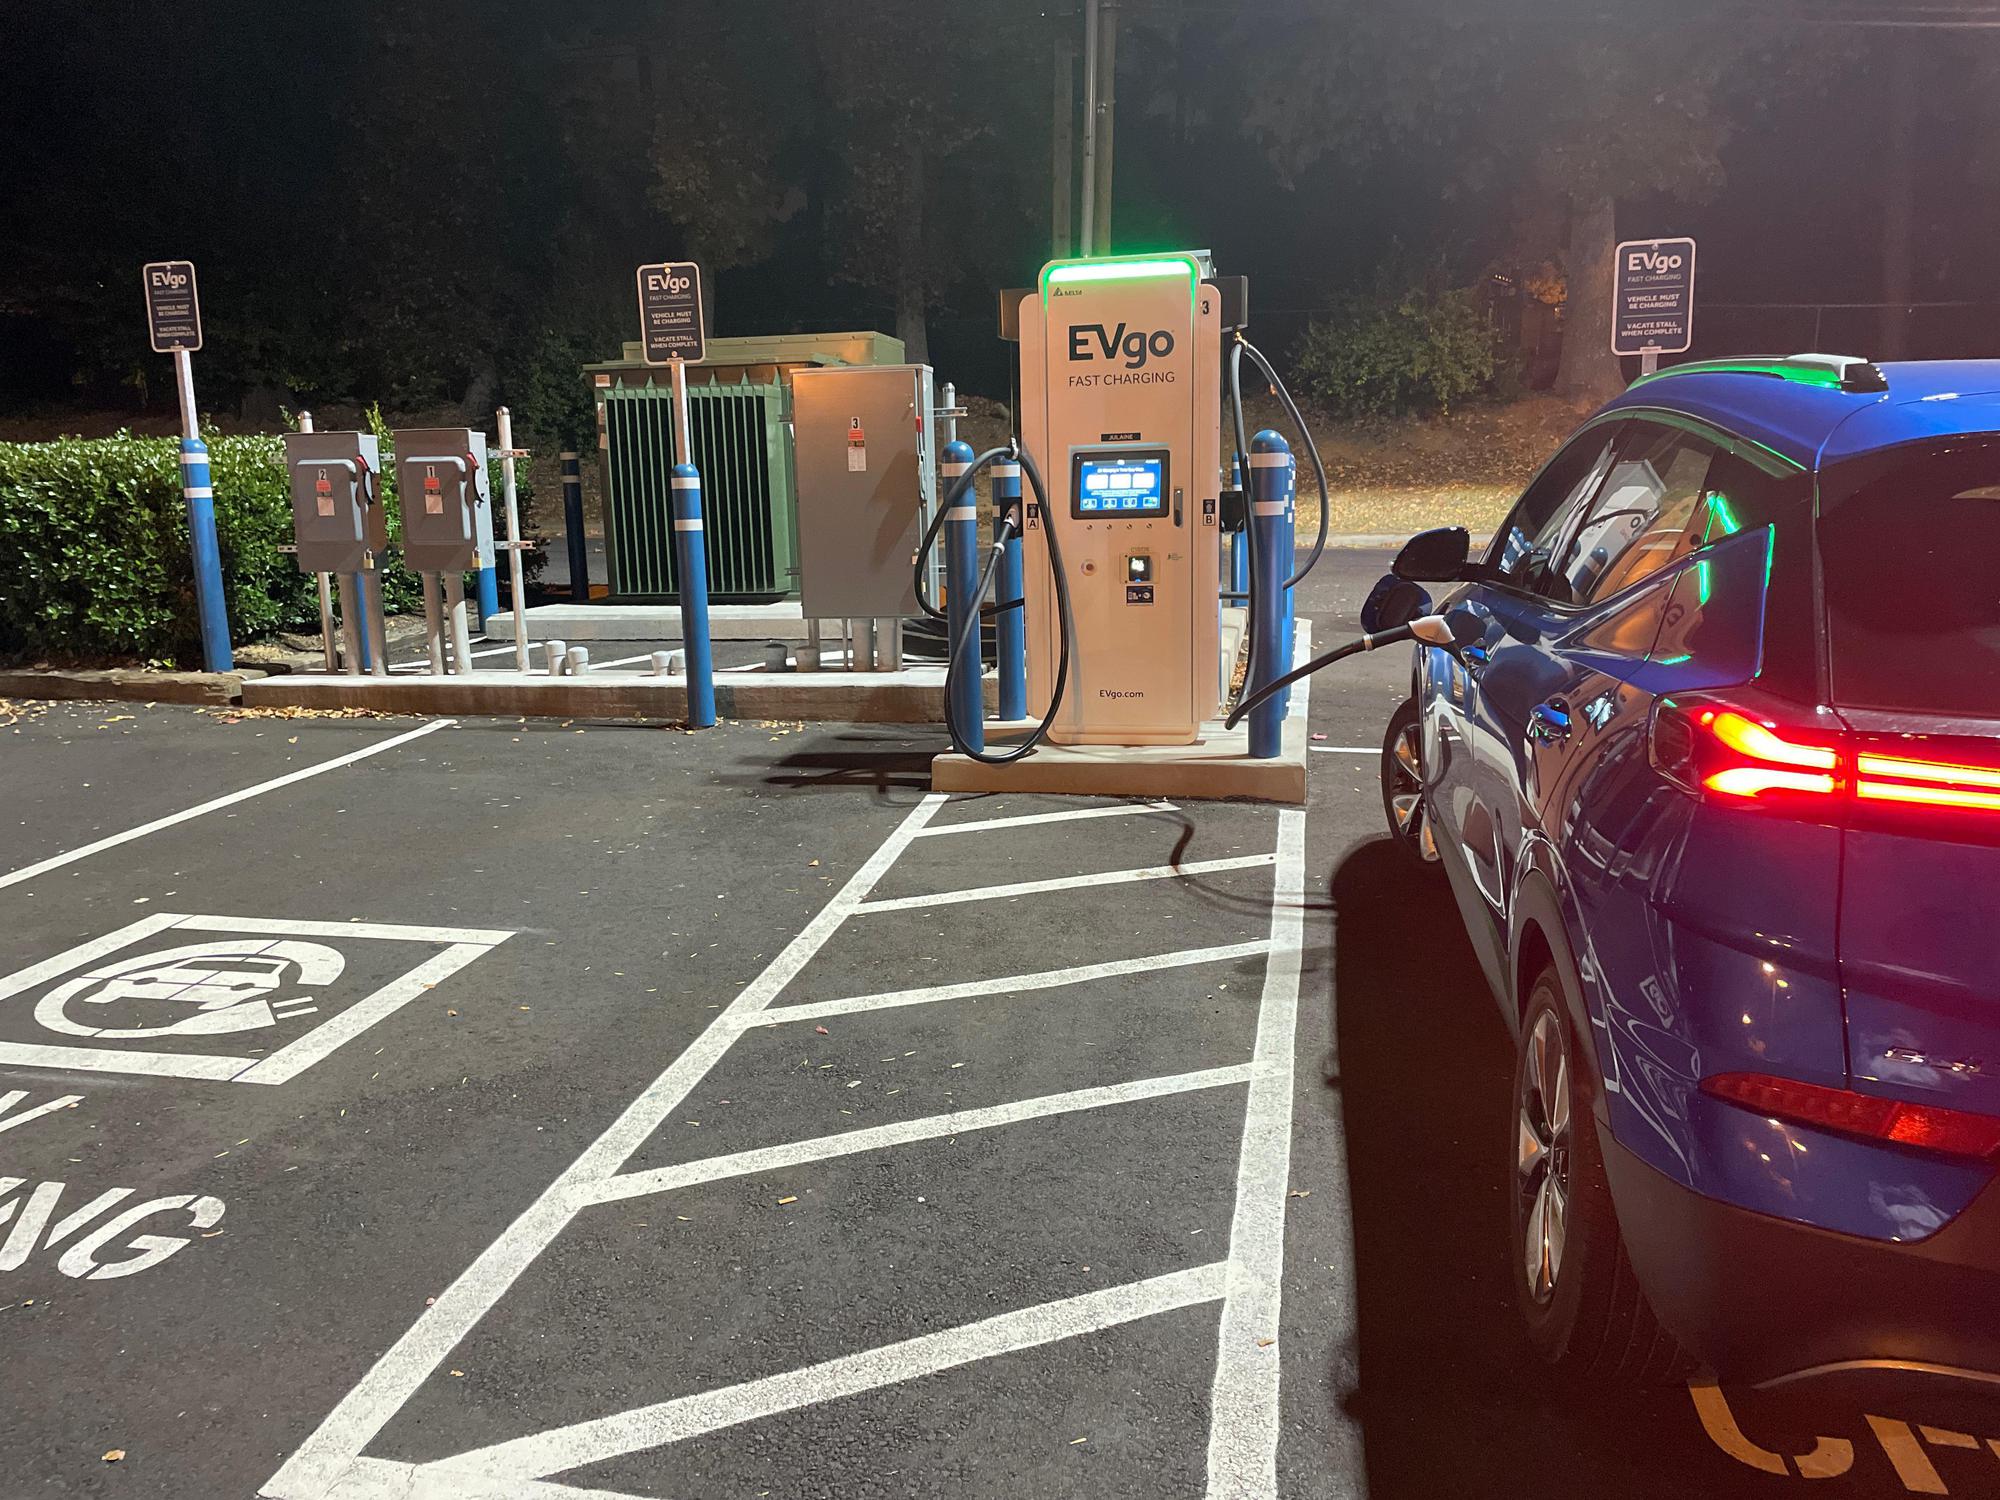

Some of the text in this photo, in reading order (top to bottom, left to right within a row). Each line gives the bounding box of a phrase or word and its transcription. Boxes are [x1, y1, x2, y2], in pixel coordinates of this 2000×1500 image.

[1628, 252, 1682, 274] EVgo
[152, 272, 187, 289] EVgo
[648, 274, 690, 294] EVgo
[1659, 293, 1680, 301] MUST
[1202, 300, 1209, 315] 3
[1639, 301, 1677, 309] CHARGING
[1644, 328, 1682, 336] COMPLETE
[1068, 322, 1175, 369] EVgo
[1069, 371, 1175, 387] FAST CHARGING
[852, 418, 858, 429] 3
[320, 470, 325, 480] 2
[1029, 520, 1036, 528] A
[1206, 515, 1212, 524] B
[1099, 689, 1144, 700] EVgo.com
